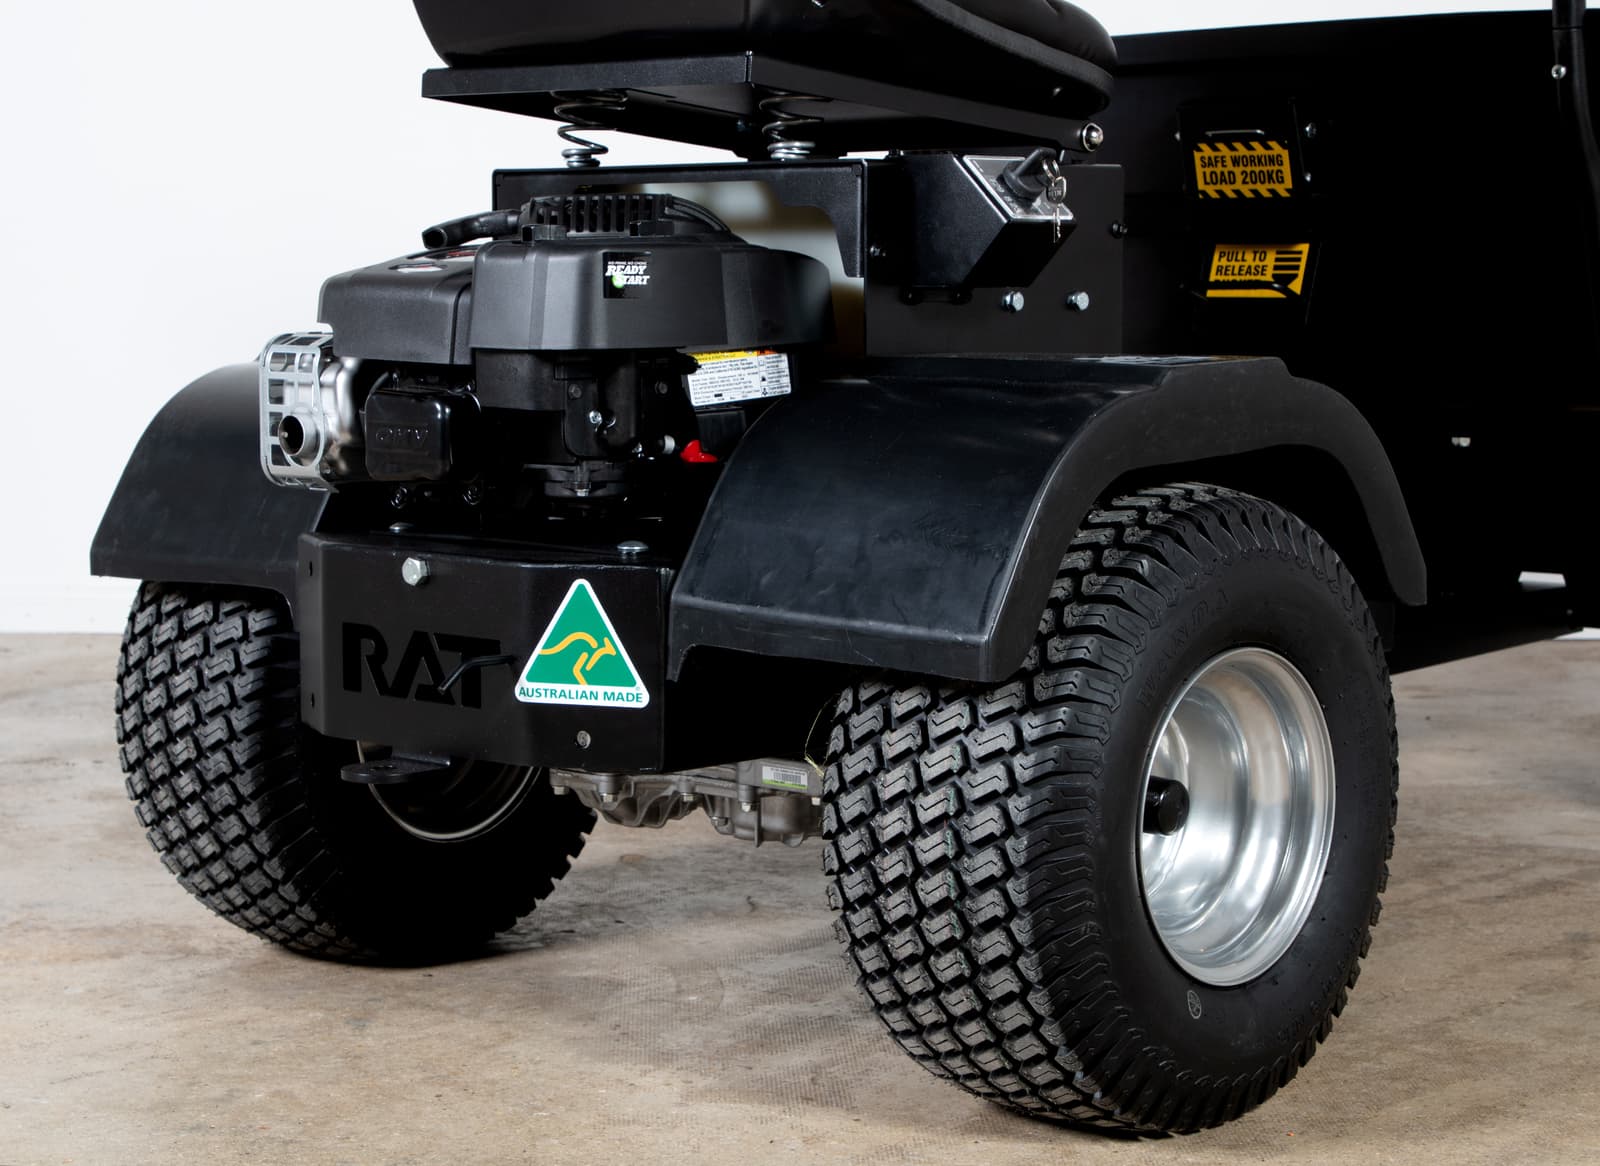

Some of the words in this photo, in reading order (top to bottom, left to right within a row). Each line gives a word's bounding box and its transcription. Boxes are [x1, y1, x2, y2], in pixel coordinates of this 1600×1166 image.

[1200, 155, 1227, 168] SAFE
[1230, 154, 1283, 168] WORKING
[1203, 170, 1236, 186] LOAD
[1241, 169, 1285, 185] 200KG
[1218, 250, 1247, 263] PULL
[1252, 250, 1267, 262] TO
[605, 265, 647, 276] READY
[1215, 264, 1268, 277] RELEASE
[342, 622, 500, 709] RAT
[518, 686, 599, 701] AUSTRALIAN
[602, 691, 643, 704] MADE
